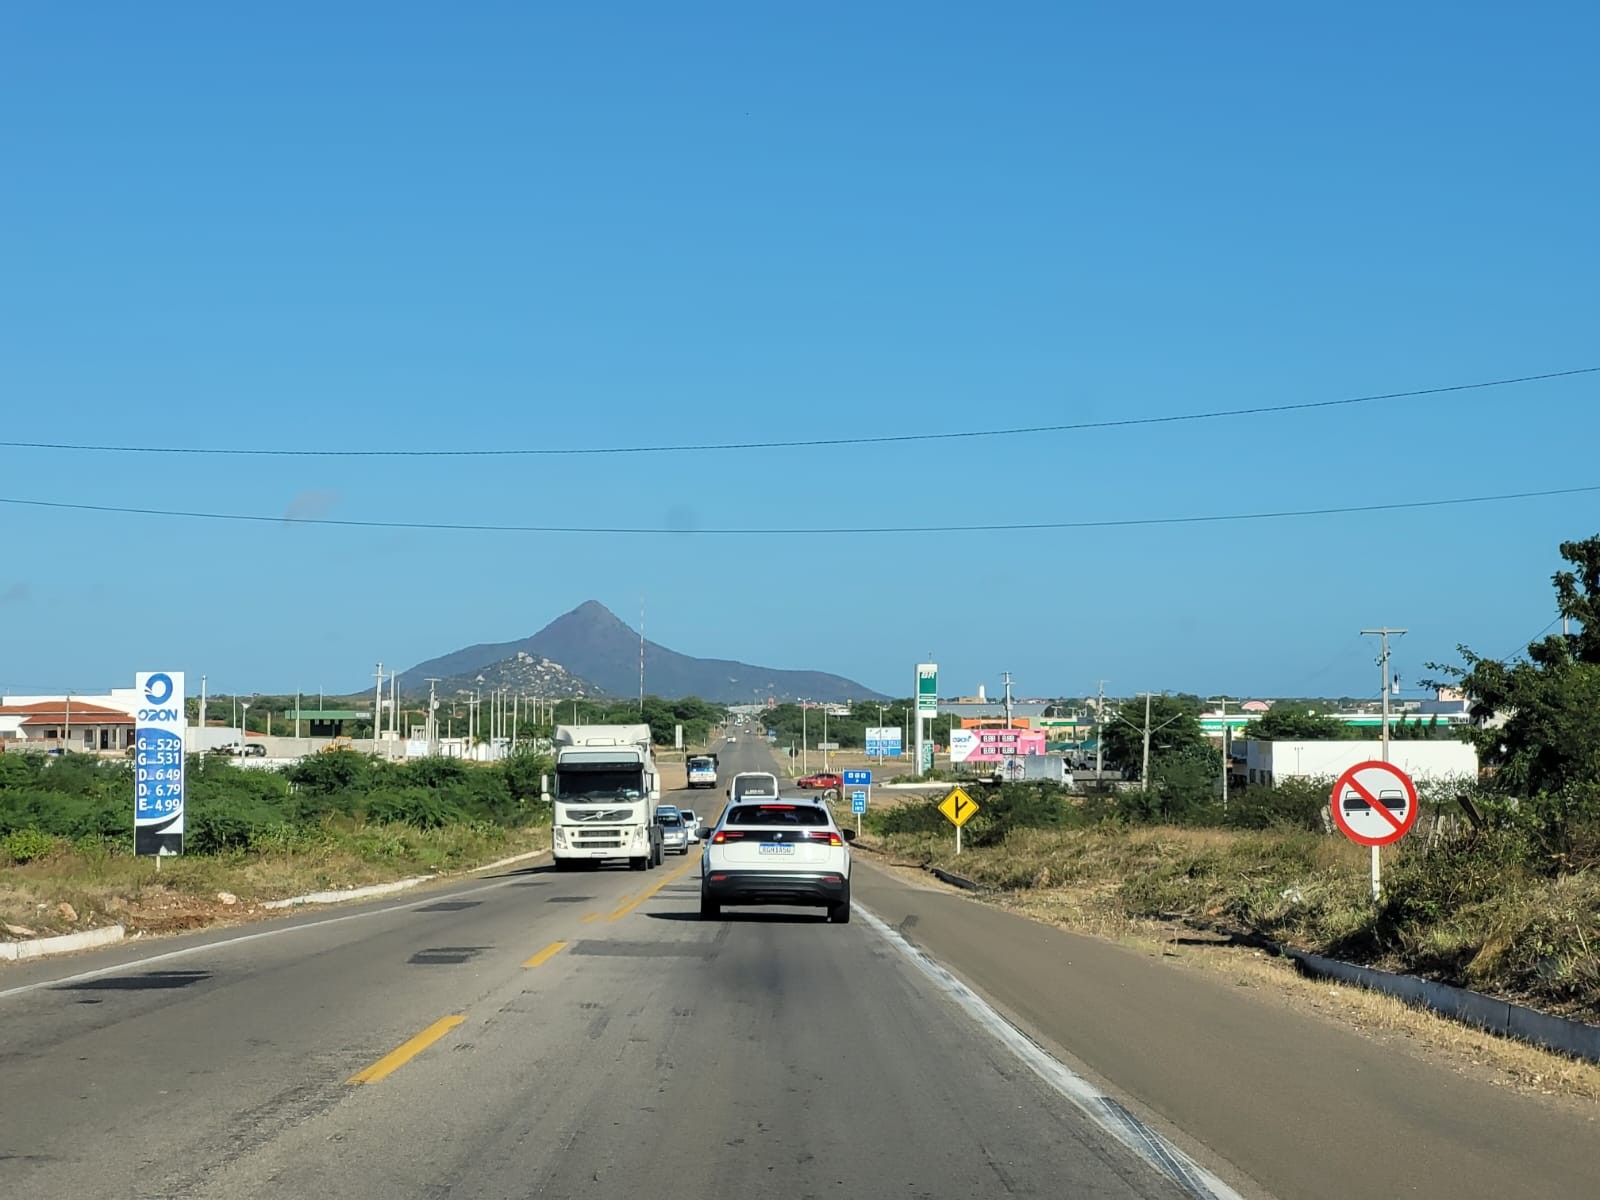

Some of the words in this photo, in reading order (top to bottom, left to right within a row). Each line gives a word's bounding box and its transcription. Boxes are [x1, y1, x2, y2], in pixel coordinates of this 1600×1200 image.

[920, 671, 935, 679] BR
[138, 708, 178, 722] OZON
[155, 783, 181, 797] 6.79
